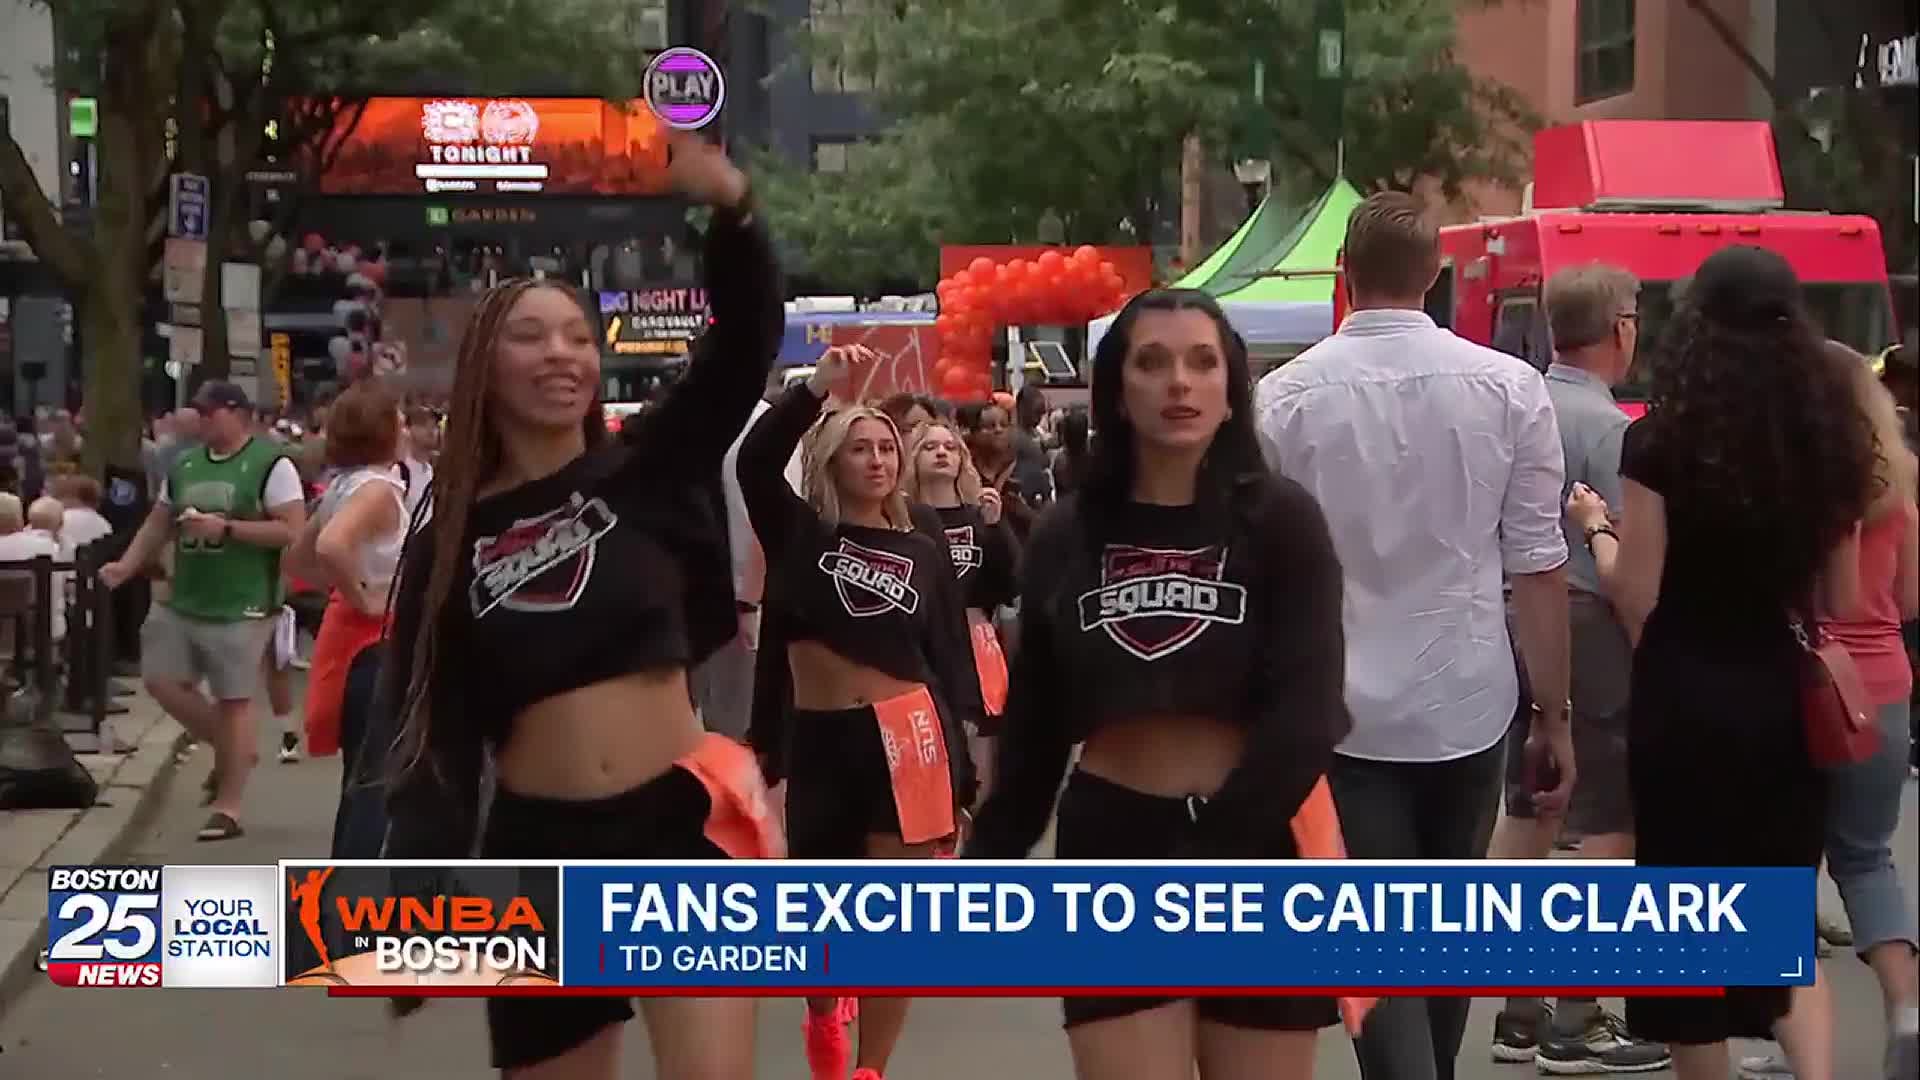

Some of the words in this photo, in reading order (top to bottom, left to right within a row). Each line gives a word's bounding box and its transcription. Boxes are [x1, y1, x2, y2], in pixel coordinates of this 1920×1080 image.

[653, 71, 713, 98] PLAY
[430, 145, 531, 162] TONIGHT
[834, 557, 905, 600] SQUAD
[1100, 581, 1218, 615] SQUAD
